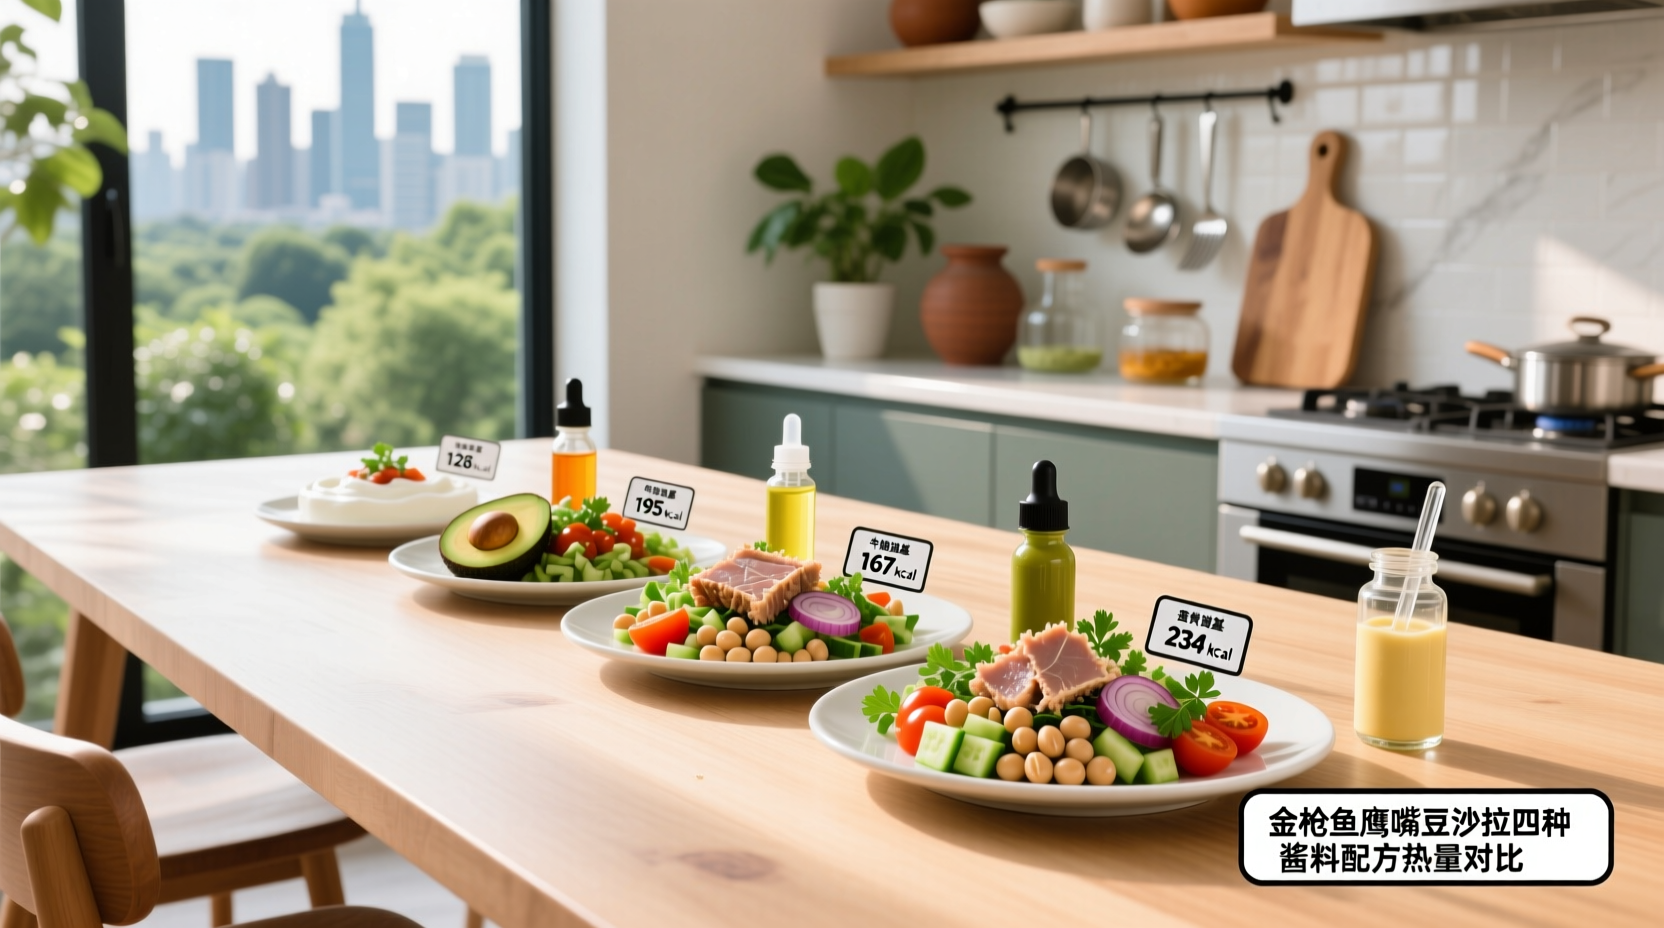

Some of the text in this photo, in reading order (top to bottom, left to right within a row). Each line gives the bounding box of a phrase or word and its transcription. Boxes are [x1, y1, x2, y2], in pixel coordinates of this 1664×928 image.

[447, 452, 473, 469] 128
[636, 497, 683, 522] 195 kcal
[861, 551, 917, 581] 167 kcal
[1164, 625, 1233, 661] 234 kcal
